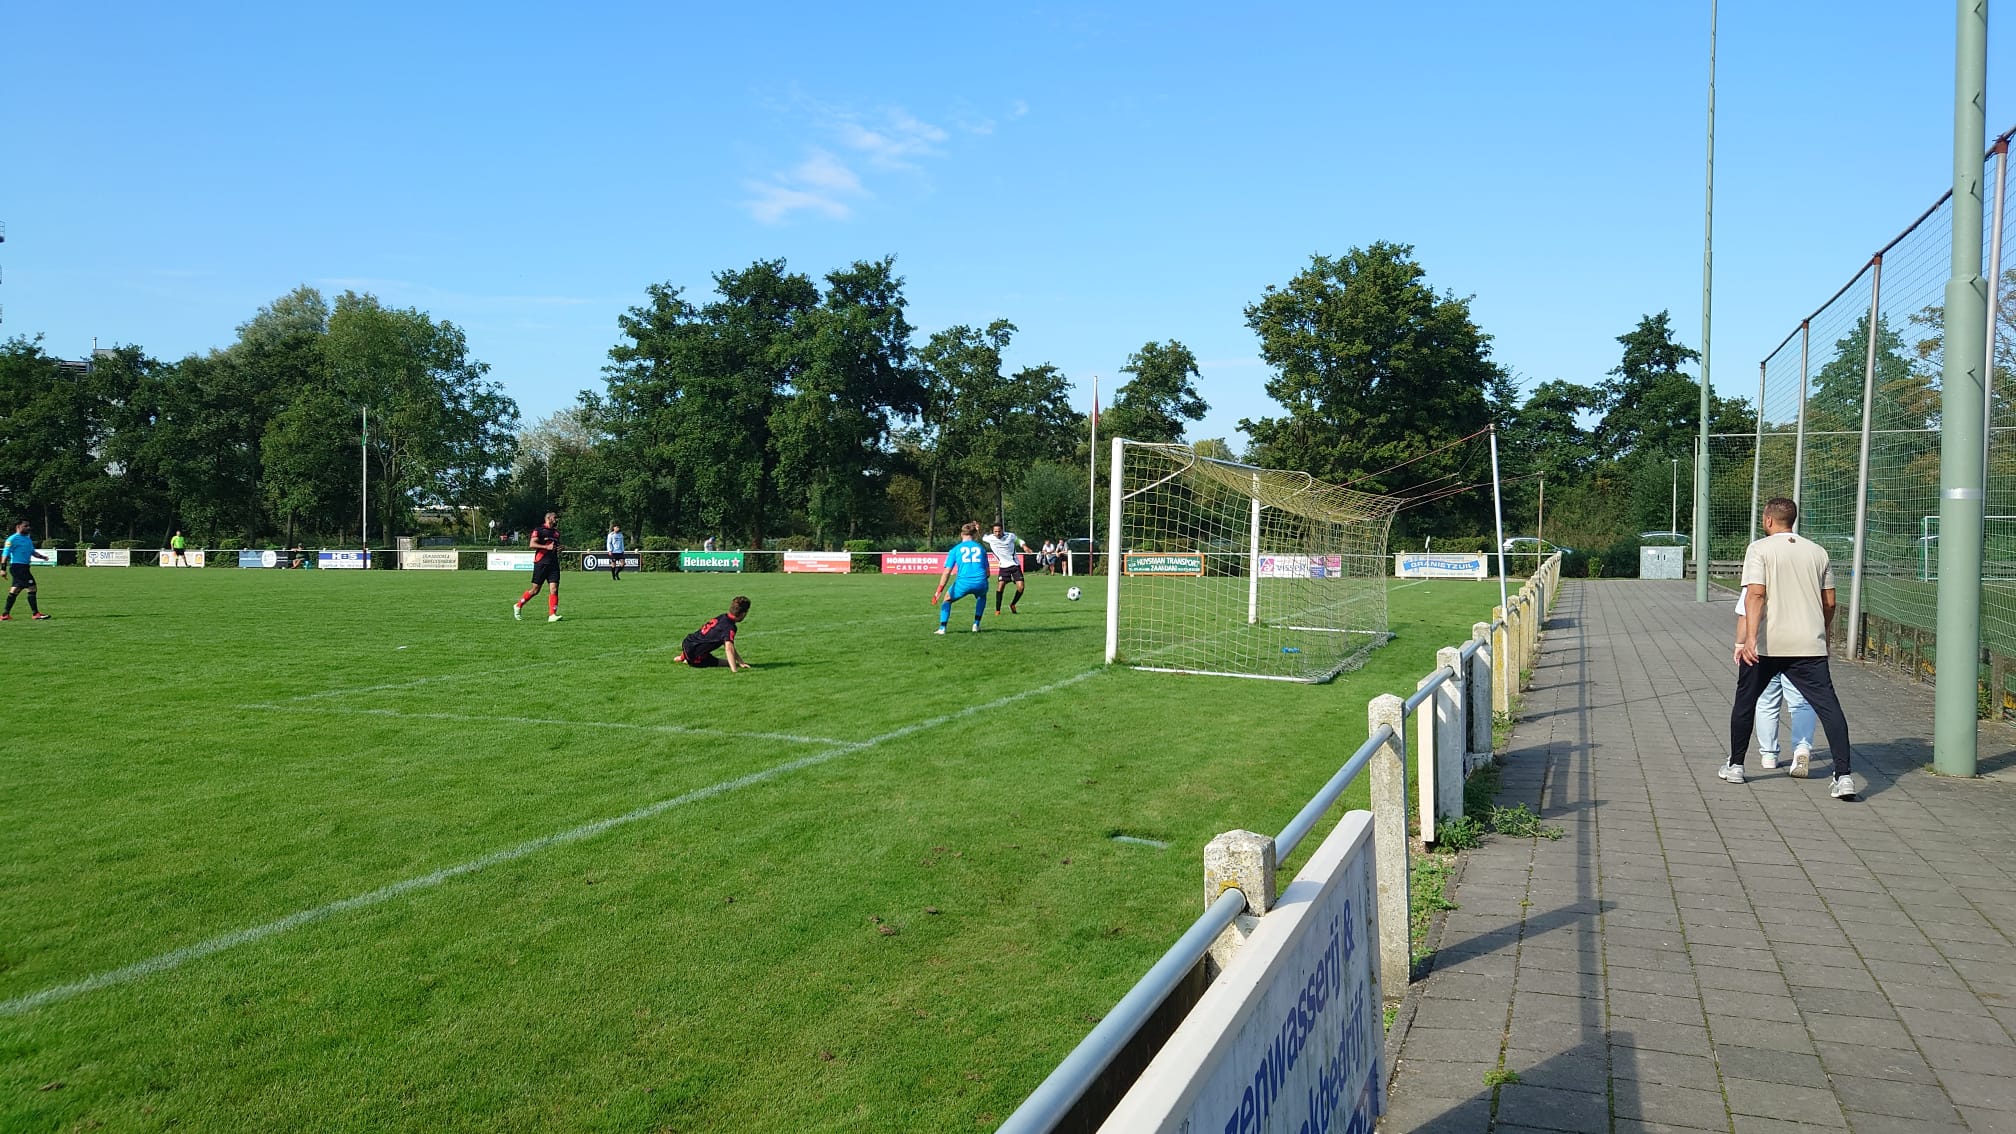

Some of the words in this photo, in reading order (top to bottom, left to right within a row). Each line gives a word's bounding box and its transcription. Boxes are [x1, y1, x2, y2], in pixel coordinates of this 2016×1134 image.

[886, 557, 939, 565] HOMMERSON
[960, 546, 982, 563] 22
[683, 557, 730, 567] Heineken
[1166, 557, 1200, 567] TRANSPORT
[1343, 899, 1355, 961] &
[1299, 979, 1363, 1134] kbedrijf
